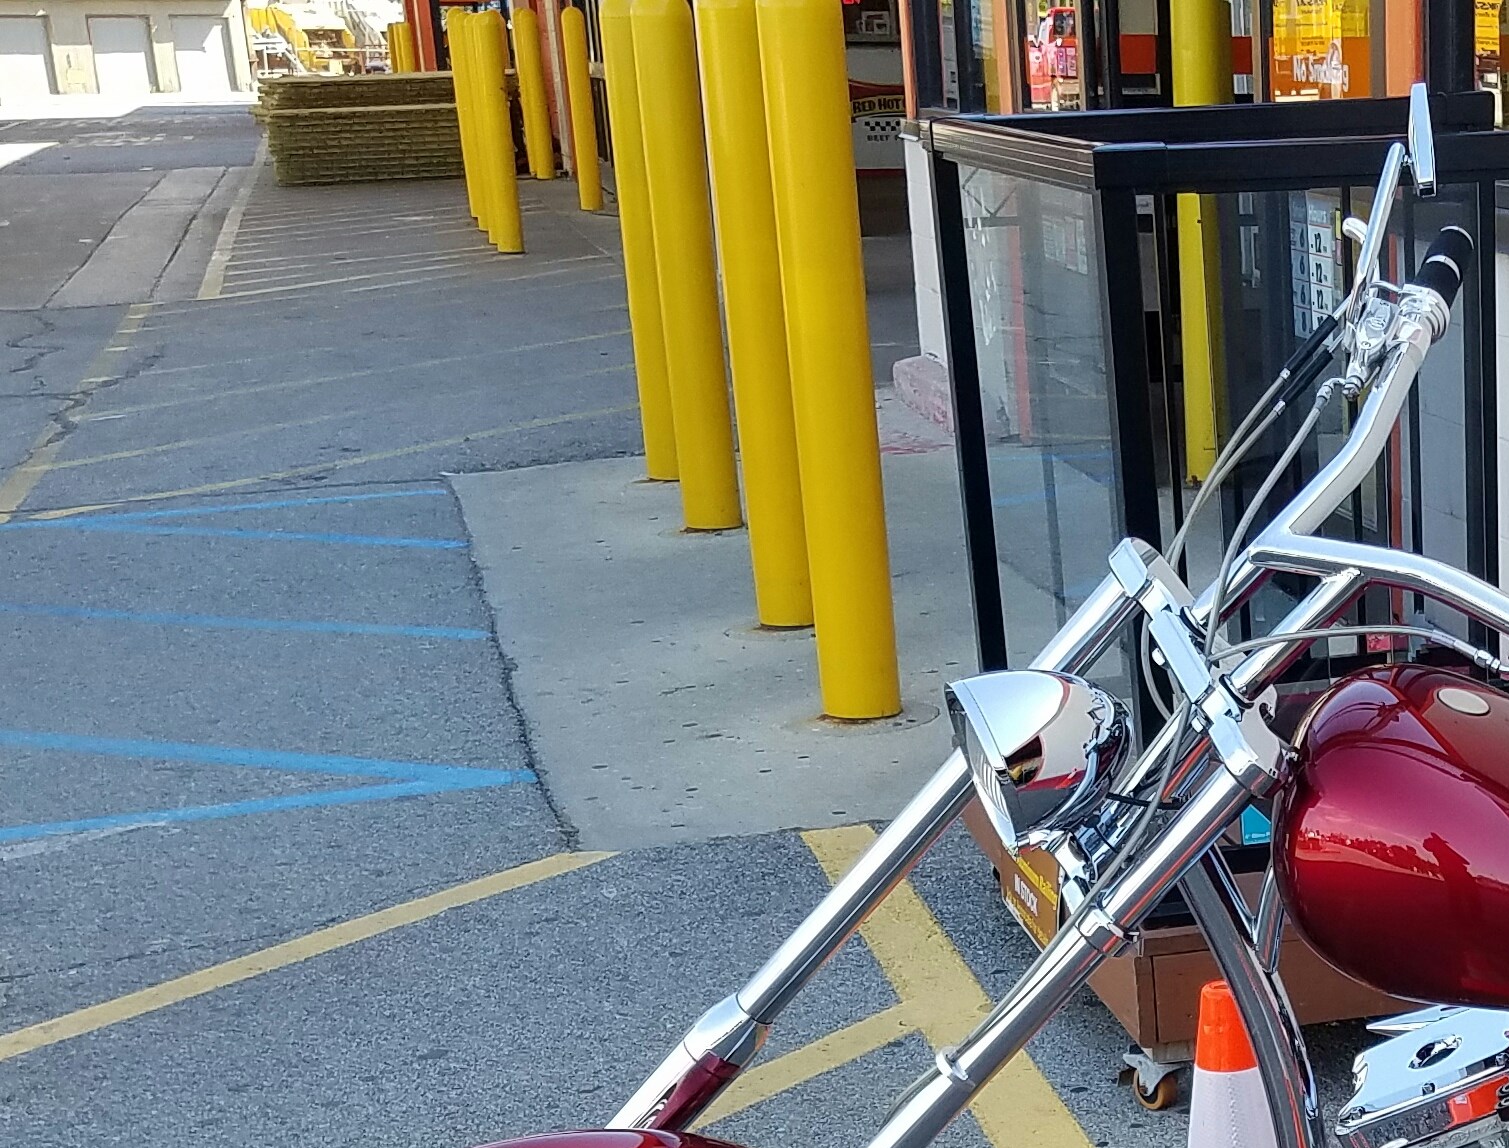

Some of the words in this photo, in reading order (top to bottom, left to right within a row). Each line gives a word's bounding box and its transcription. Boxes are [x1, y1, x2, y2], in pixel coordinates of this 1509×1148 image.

[1292, 55, 1306, 82] No
[1308, 55, 1349, 92] Smoking
[853, 100, 876, 113] RED
[878, 98, 901, 110] HOT
[1020, 880, 1038, 917] STOCK
